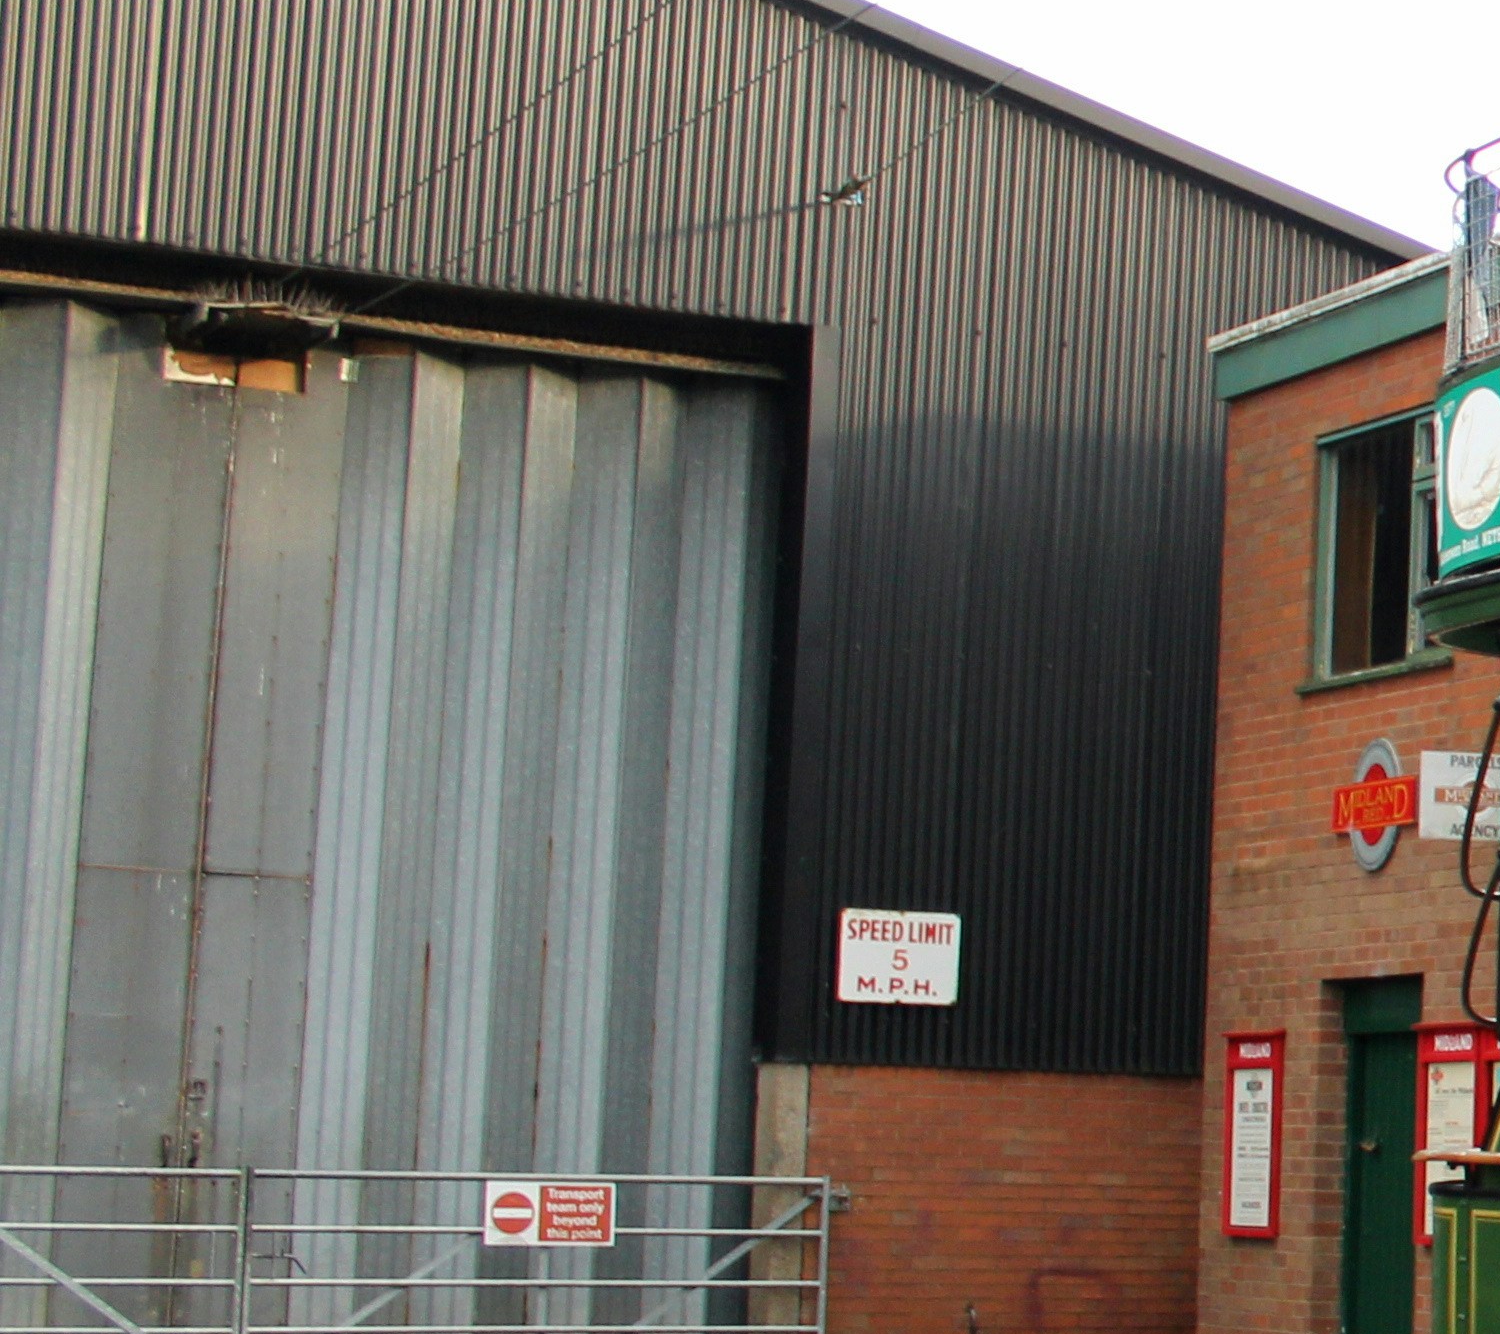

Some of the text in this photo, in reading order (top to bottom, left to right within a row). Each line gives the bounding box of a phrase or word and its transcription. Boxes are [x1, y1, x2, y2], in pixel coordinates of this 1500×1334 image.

[1338, 783, 1408, 825] MIDLAND
[847, 919, 954, 945] SPEED LIMIT
[891, 949, 909, 971] 5
[548, 1187, 605, 1202] Transport
[546, 1201, 605, 1216] team only
[553, 1214, 597, 1228] beyond
[546, 1228, 602, 1241] this point
